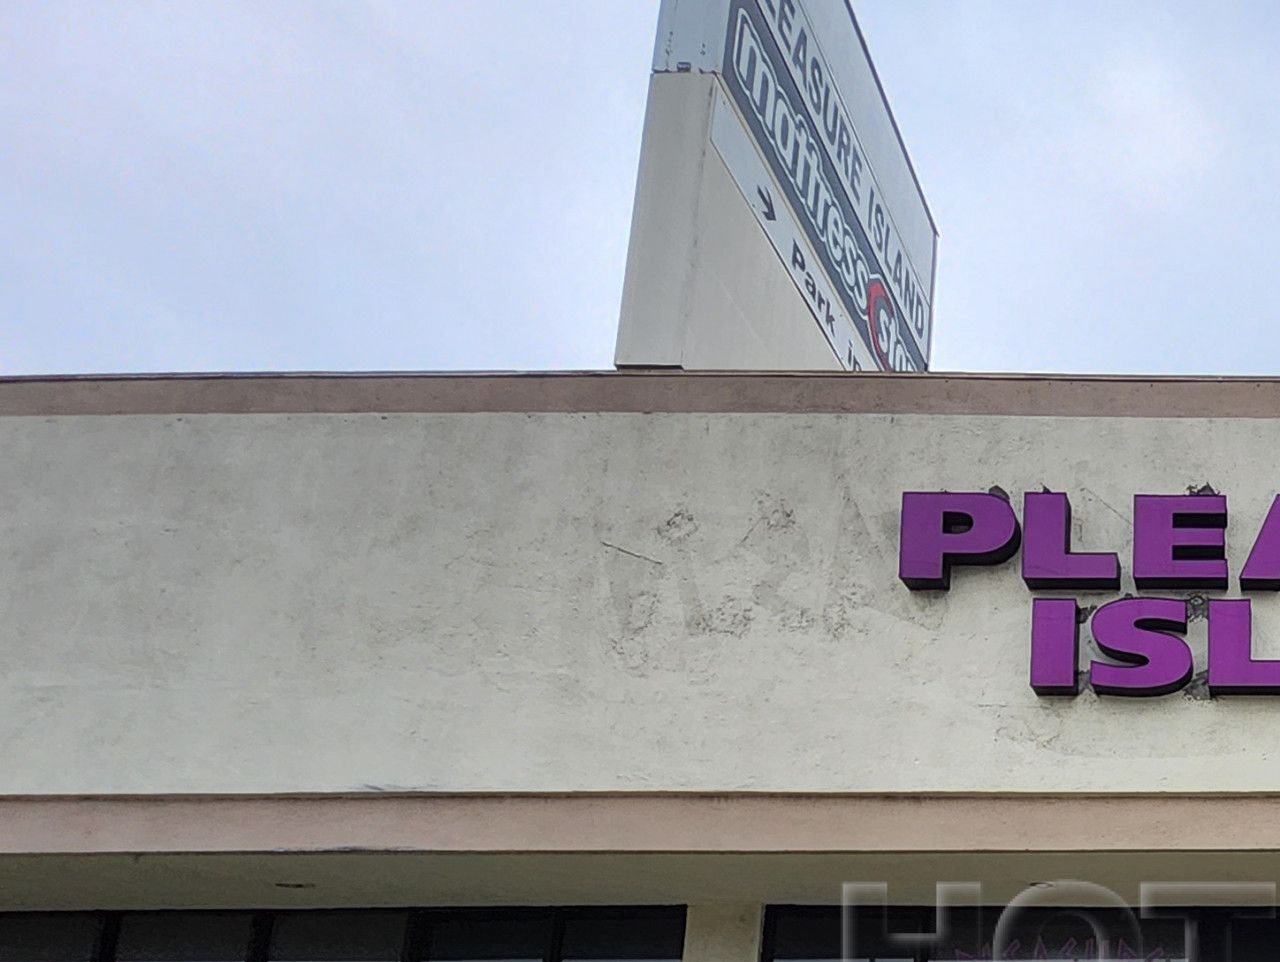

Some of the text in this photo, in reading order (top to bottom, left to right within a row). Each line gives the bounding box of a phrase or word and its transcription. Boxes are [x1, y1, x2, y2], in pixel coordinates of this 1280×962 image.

[735, 14, 918, 371] mattress sto
[764, 0, 926, 340] EASURE ISLAND
[791, 237, 836, 338] Park
